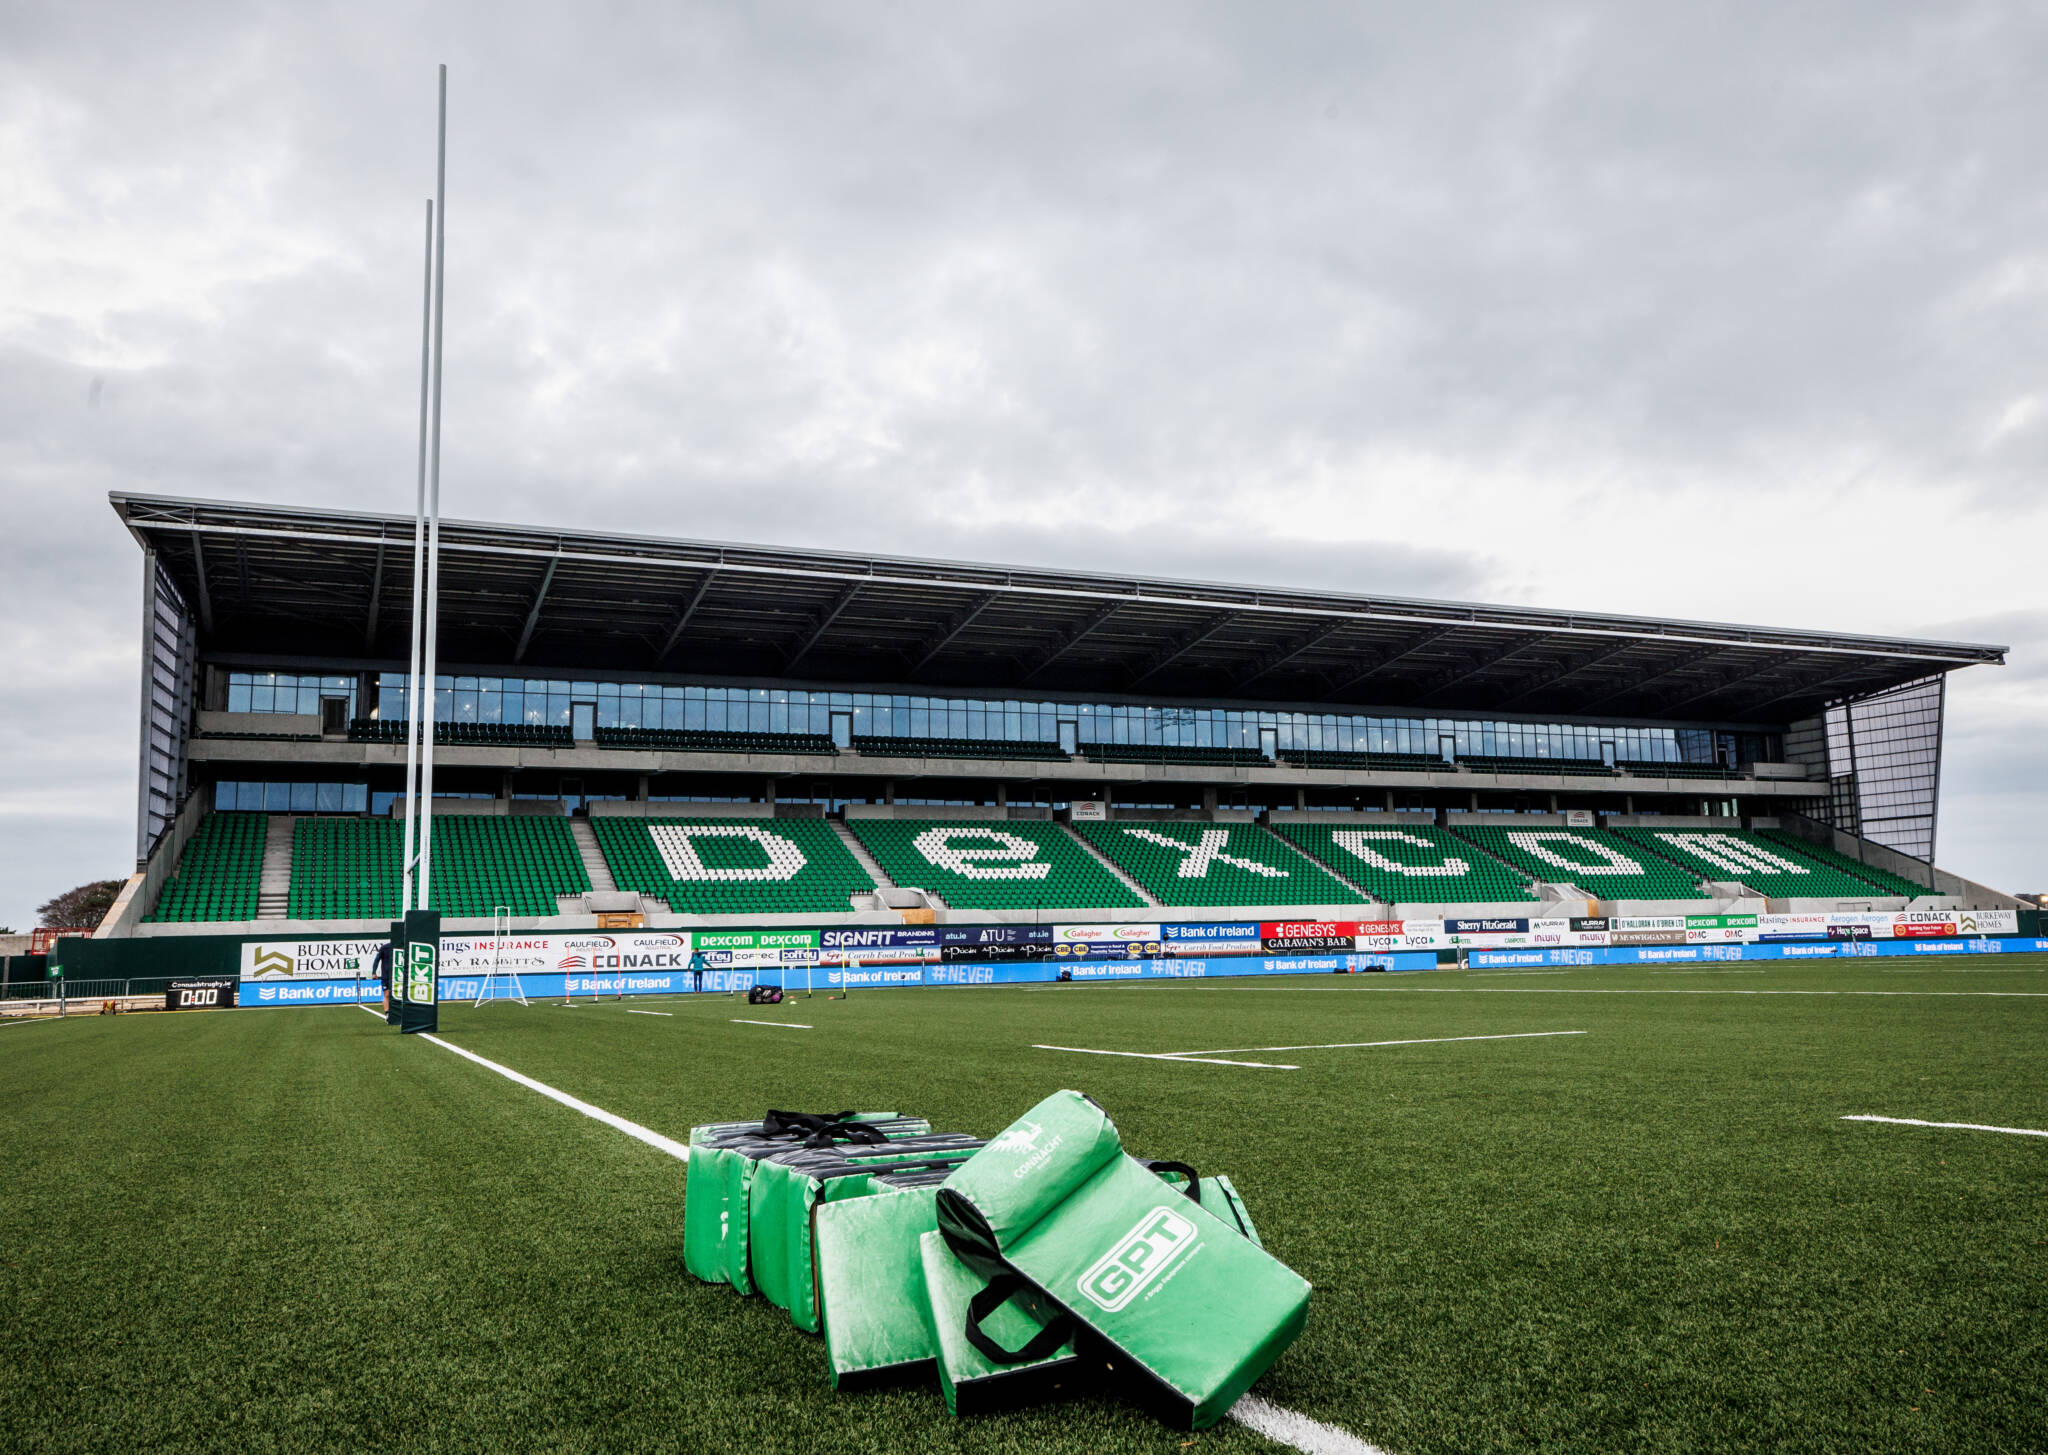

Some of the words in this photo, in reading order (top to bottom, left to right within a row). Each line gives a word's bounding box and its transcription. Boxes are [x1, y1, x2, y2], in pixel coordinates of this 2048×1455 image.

[1759, 916, 1788, 924] Hastings
[1831, 914, 1858, 923] Aerogen
[1862, 914, 1888, 923] Aerogen
[1910, 913, 1952, 922] CONACK
[1976, 912, 2012, 920] BURKEWAY
[1286, 924, 1336, 937] GENESYS
[1365, 924, 1400, 933] GENESYS
[1457, 921, 1481, 932] Sherry
[1482, 920, 1517, 929] FitzGerald
[1977, 921, 2002, 929] HOMES
[945, 932, 966, 940] atu.ie
[980, 930, 1005, 942] ATU
[1071, 930, 1102, 938] Gallagher
[1120, 929, 1150, 938] Gallagher
[1180, 926, 1206, 937] Bank
[1207, 926, 1218, 936] of
[1219, 926, 1254, 937] Ireland
[1687, 930, 1707, 939] OMC
[1723, 930, 1743, 938] OMC
[564, 940, 610, 948] CAULFIELD
[823, 931, 895, 946] SIGNFIT
[1268, 937, 1324, 948] GARAVAN'S
[1327, 937, 1347, 946] BAR
[1368, 936, 1391, 947] Lyca
[1405, 935, 1428, 946] Lyca
[474, 941, 549, 950] INSURANCE
[848, 950, 876, 960] Corrib
[878, 949, 898, 959] Food
[1489, 954, 1506, 964] Bank
[1507, 953, 1515, 963] of
[1516, 953, 1543, 963] Ireland
[1550, 950, 1593, 965] #NEVER
[1703, 946, 1742, 960] #NEVER
[593, 954, 682, 968] CONACK
[1276, 960, 1297, 970] Bank
[1298, 959, 1307, 969] of
[1308, 959, 1337, 970] Ireland
[414, 946, 429, 1001] BKT
[932, 965, 993, 983] #NEVER
[1073, 966, 1095, 976] Bank
[1096, 965, 1107, 975] of
[1108, 965, 1141, 976] Ireland
[1151, 960, 1206, 977] #NEVER
[844, 971, 868, 982] Bank
[870, 970, 882, 981] of
[884, 970, 921, 981] Ireland
[582, 978, 612, 991] Bank
[613, 977, 627, 990] of
[628, 977, 670, 989] Ireland
[180, 988, 218, 1006] 0:00
[279, 987, 313, 1000] Bank
[315, 986, 332, 998] of
[334, 985, 383, 999] Ireland
[1014, 1135, 1063, 1179] CONNACHT
[1090, 1214, 1179, 1301] GPT
